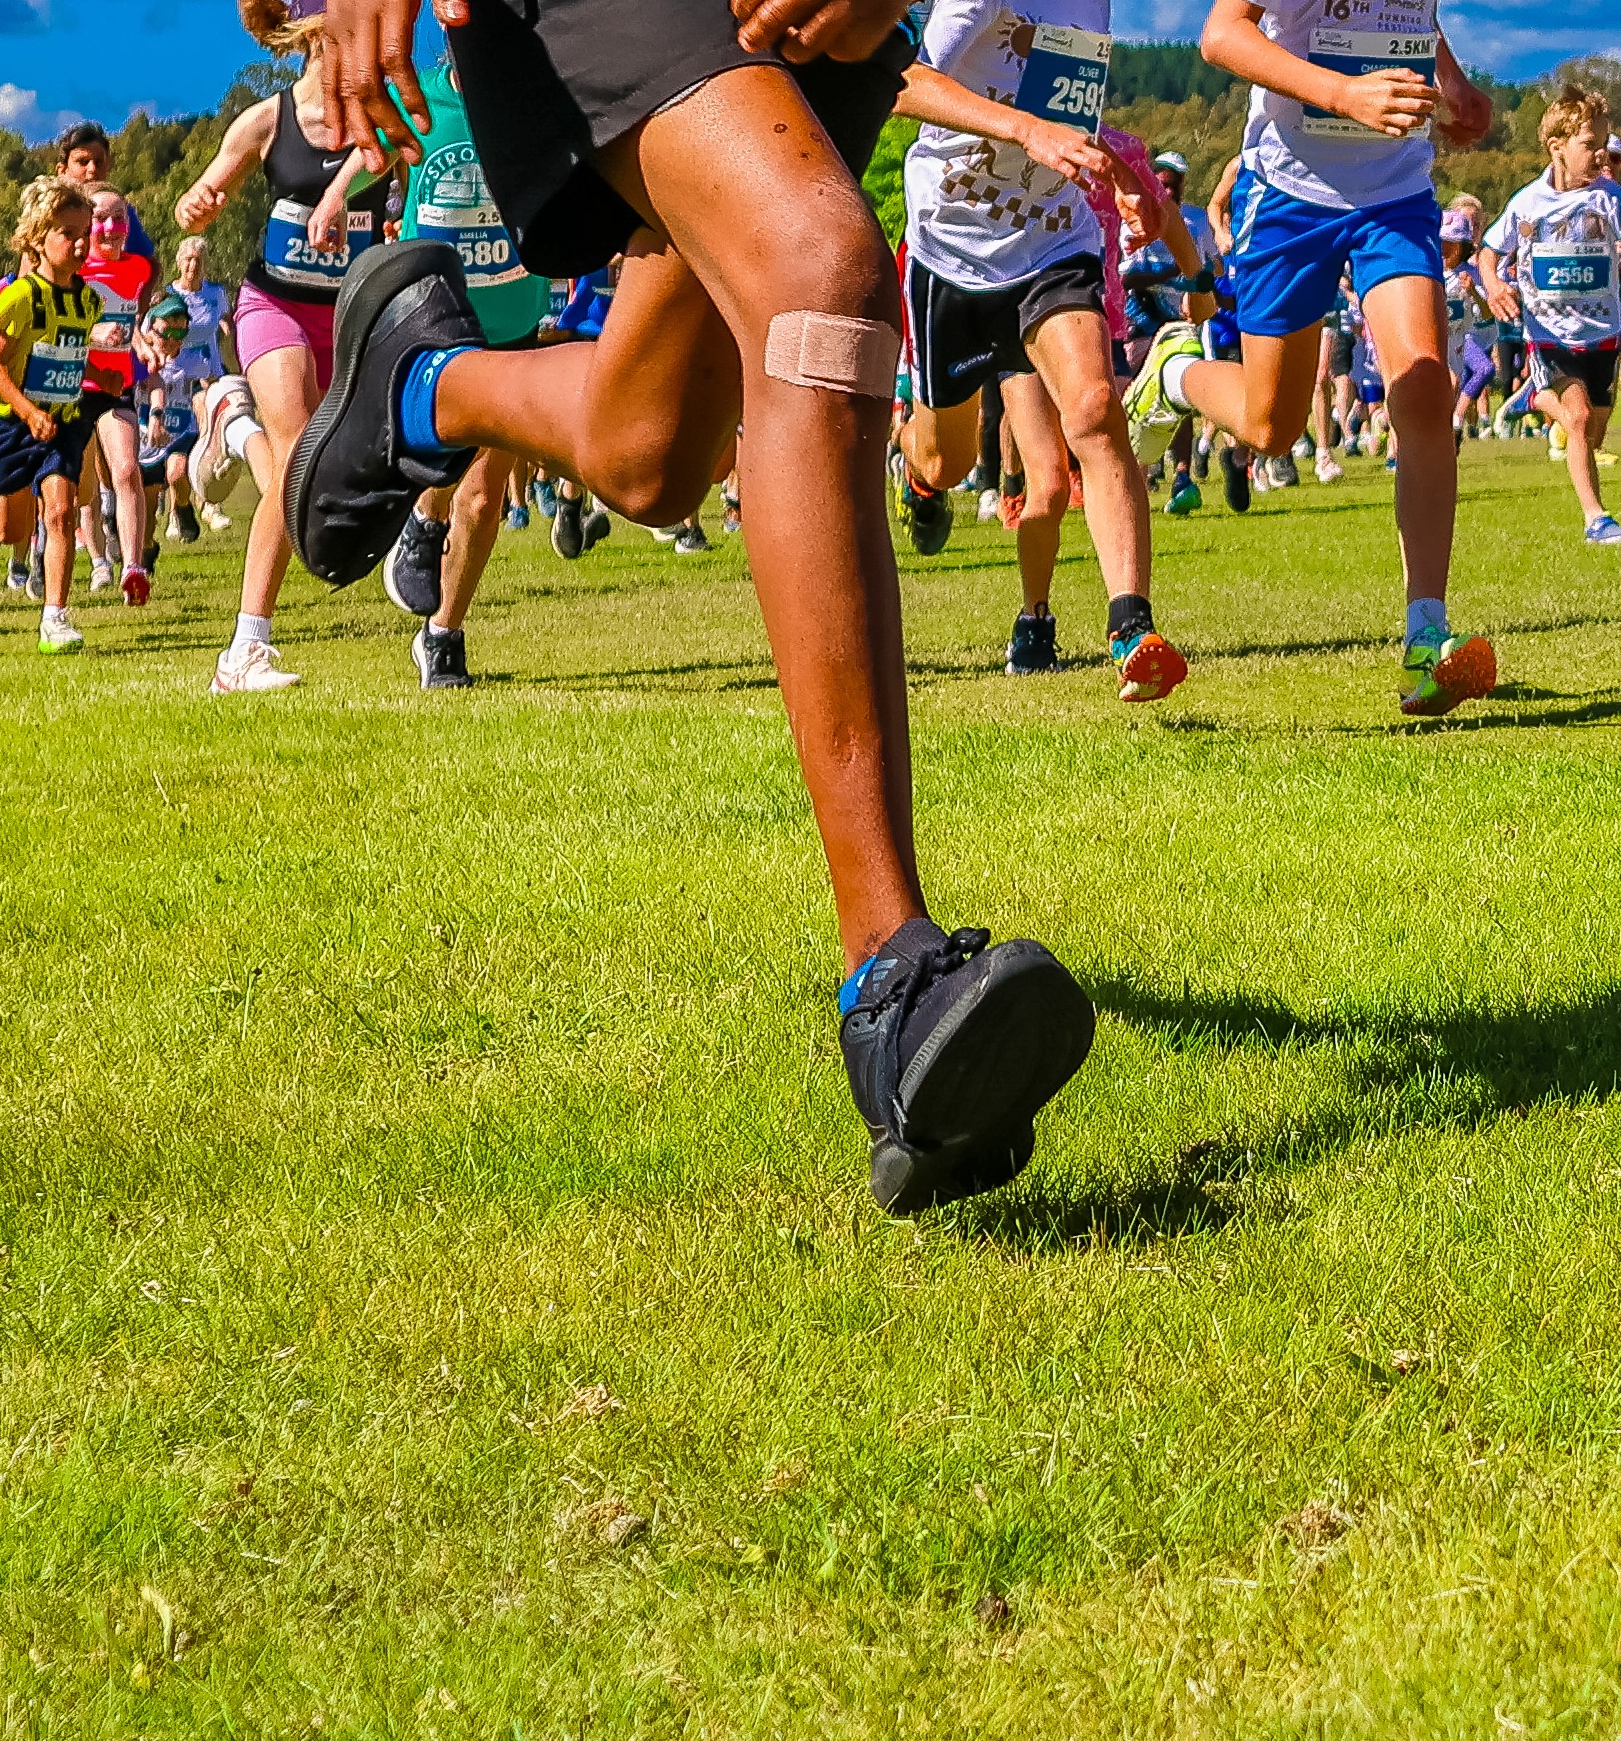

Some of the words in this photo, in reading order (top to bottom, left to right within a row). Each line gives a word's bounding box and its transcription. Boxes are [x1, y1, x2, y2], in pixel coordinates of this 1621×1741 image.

[1389, 39, 1430, 55] 2.5KM
[1078, 65, 1100, 79] OLIVER
[427, 148, 475, 180] STRO
[451, 240, 509, 266] 580
[1548, 266, 1594, 285] 2556
